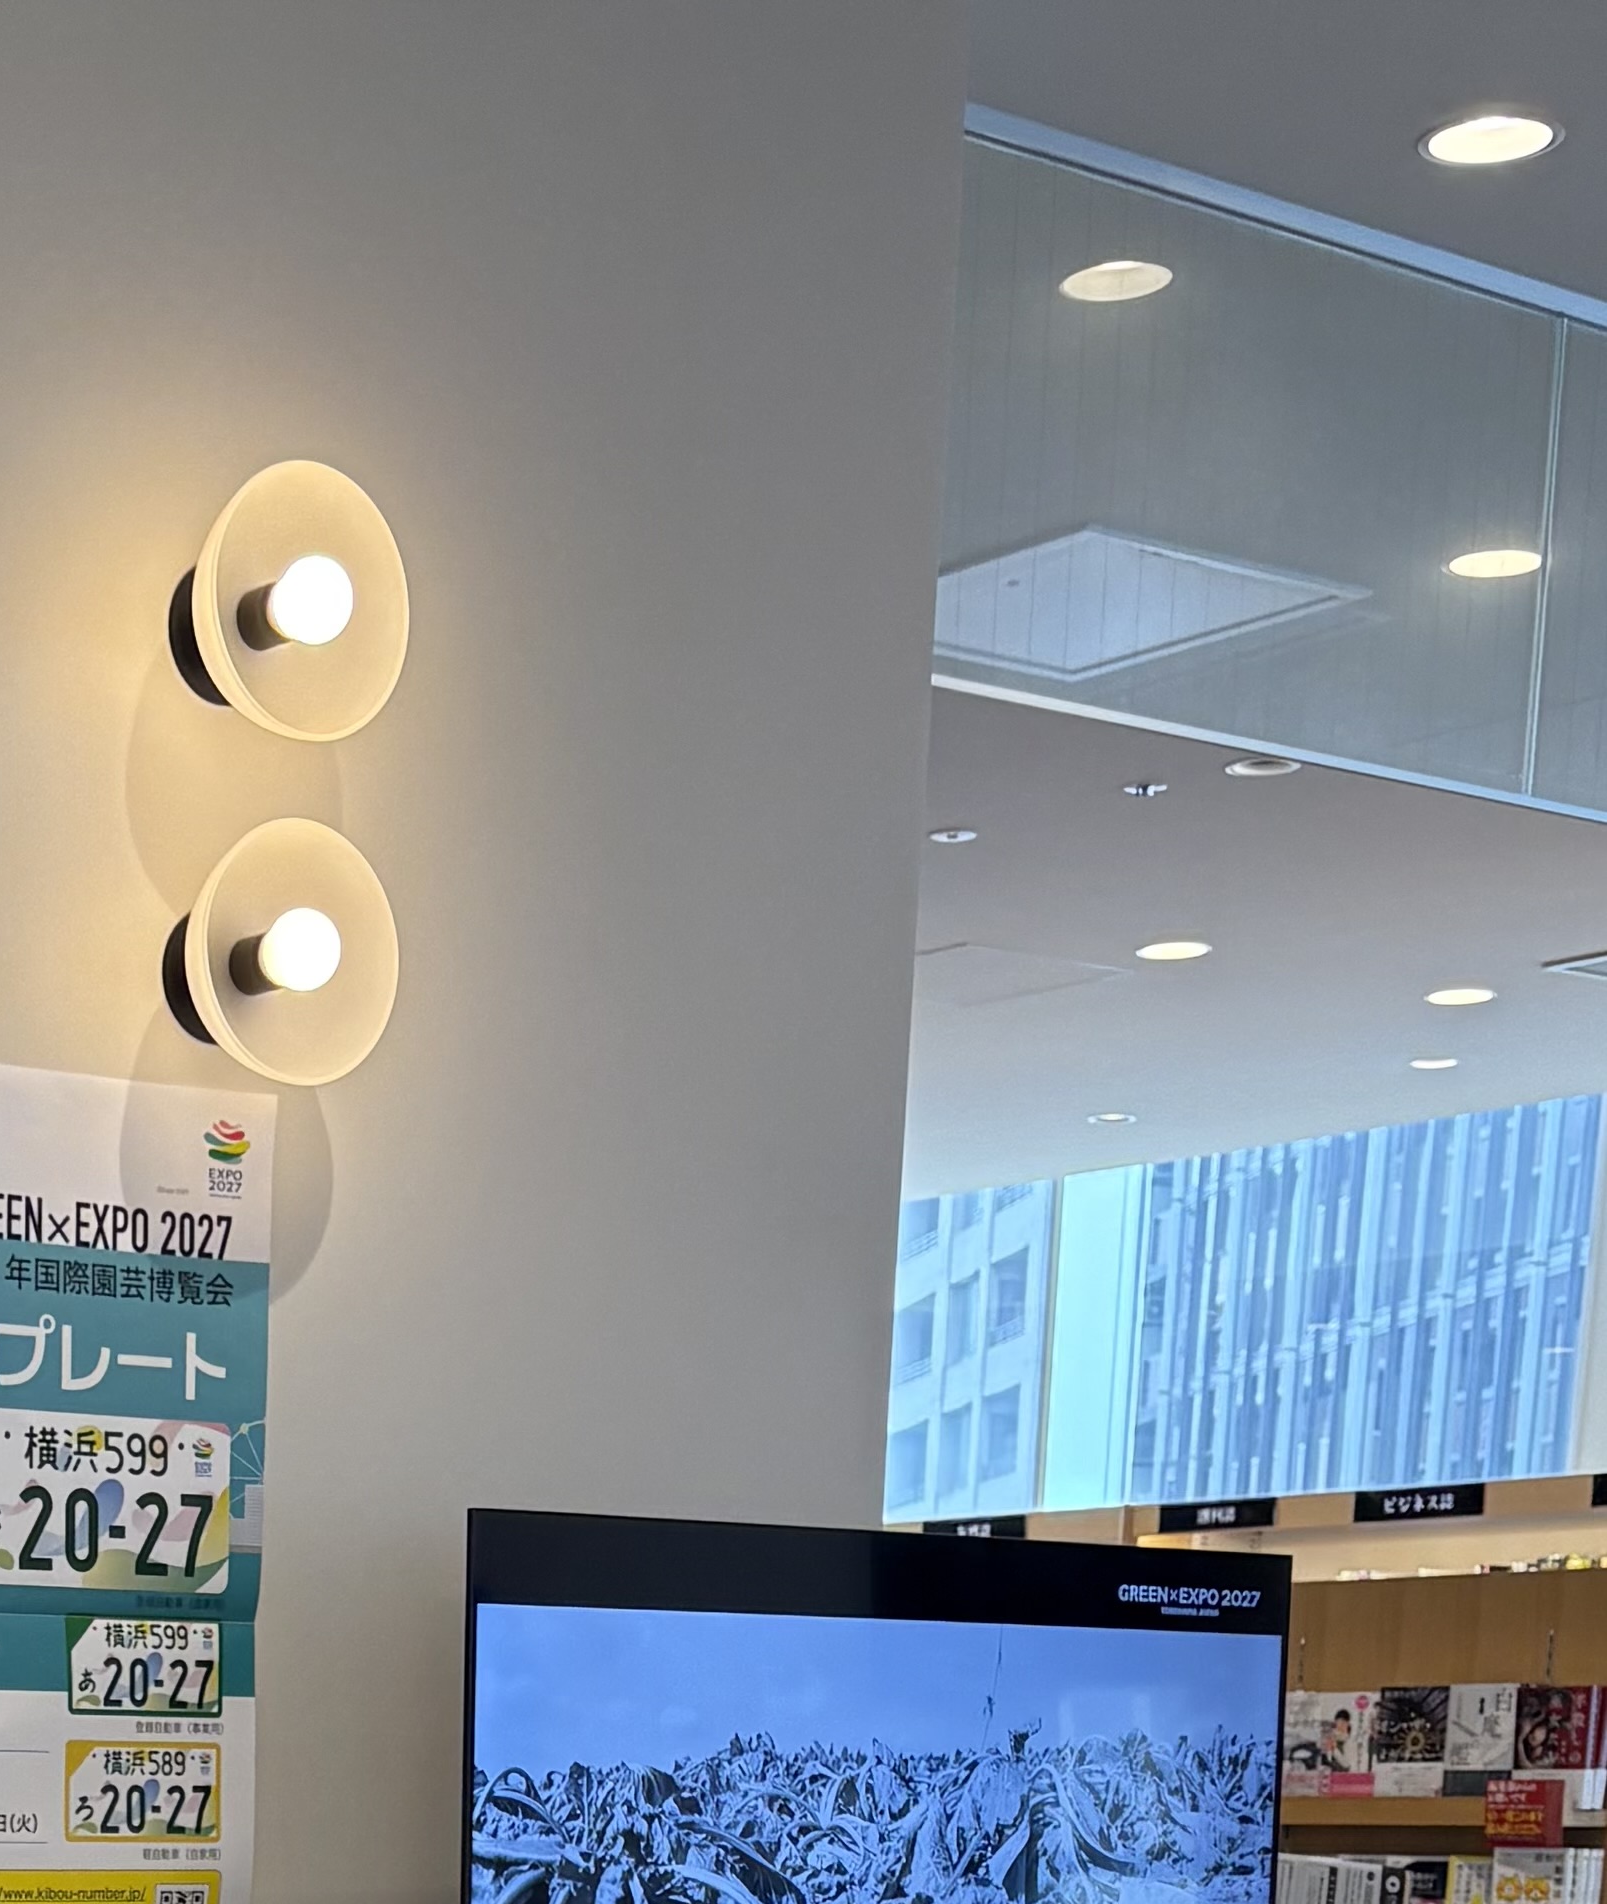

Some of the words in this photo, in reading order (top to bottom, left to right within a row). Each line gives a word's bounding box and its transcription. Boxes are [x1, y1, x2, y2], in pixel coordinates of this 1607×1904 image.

[208, 1168, 242, 1181] EXPO
[208, 1180, 242, 1193] 2027
[161, 1212, 233, 1261] 2027
[19, 1485, 213, 1577] 20-27
[1222, 1589, 1261, 1608] 2027
[78, 1667, 96, 1693] あ
[103, 1657, 214, 1709] 20-27
[75, 1796, 94, 1821] ろ
[100, 1784, 212, 1834] 20-27
